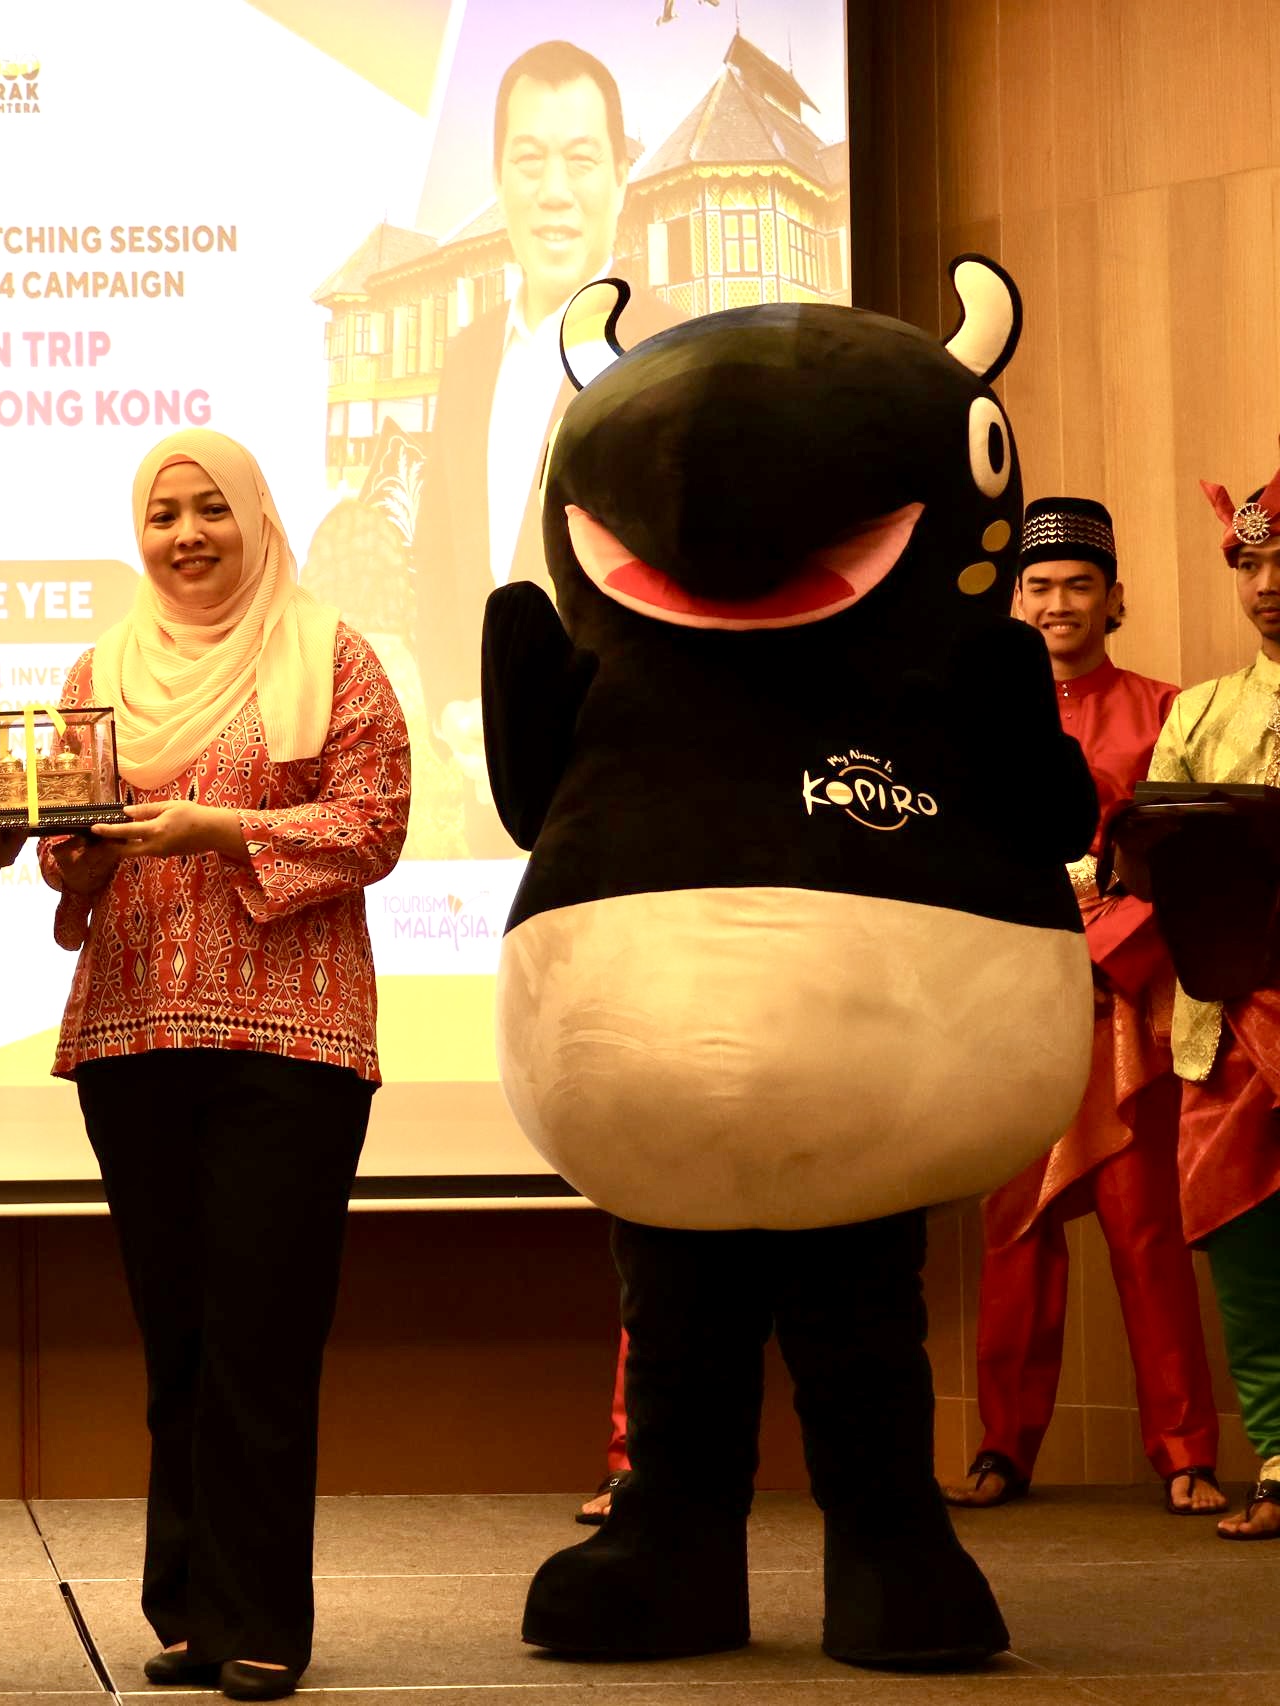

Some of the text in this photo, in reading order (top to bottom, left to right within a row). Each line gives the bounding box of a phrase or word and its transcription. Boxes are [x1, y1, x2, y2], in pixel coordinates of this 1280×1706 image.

[110, 225, 237, 254] SESSION
[22, 270, 185, 299] CAMPAIGN
[22, 331, 111, 367] TRIP
[95, 388, 211, 426] KONG
[16, 582, 93, 620] YEE
[803, 769, 938, 816] KOPIRO
[382, 895, 447, 914] TOURISM
[393, 914, 490, 952] MALAYSIA
